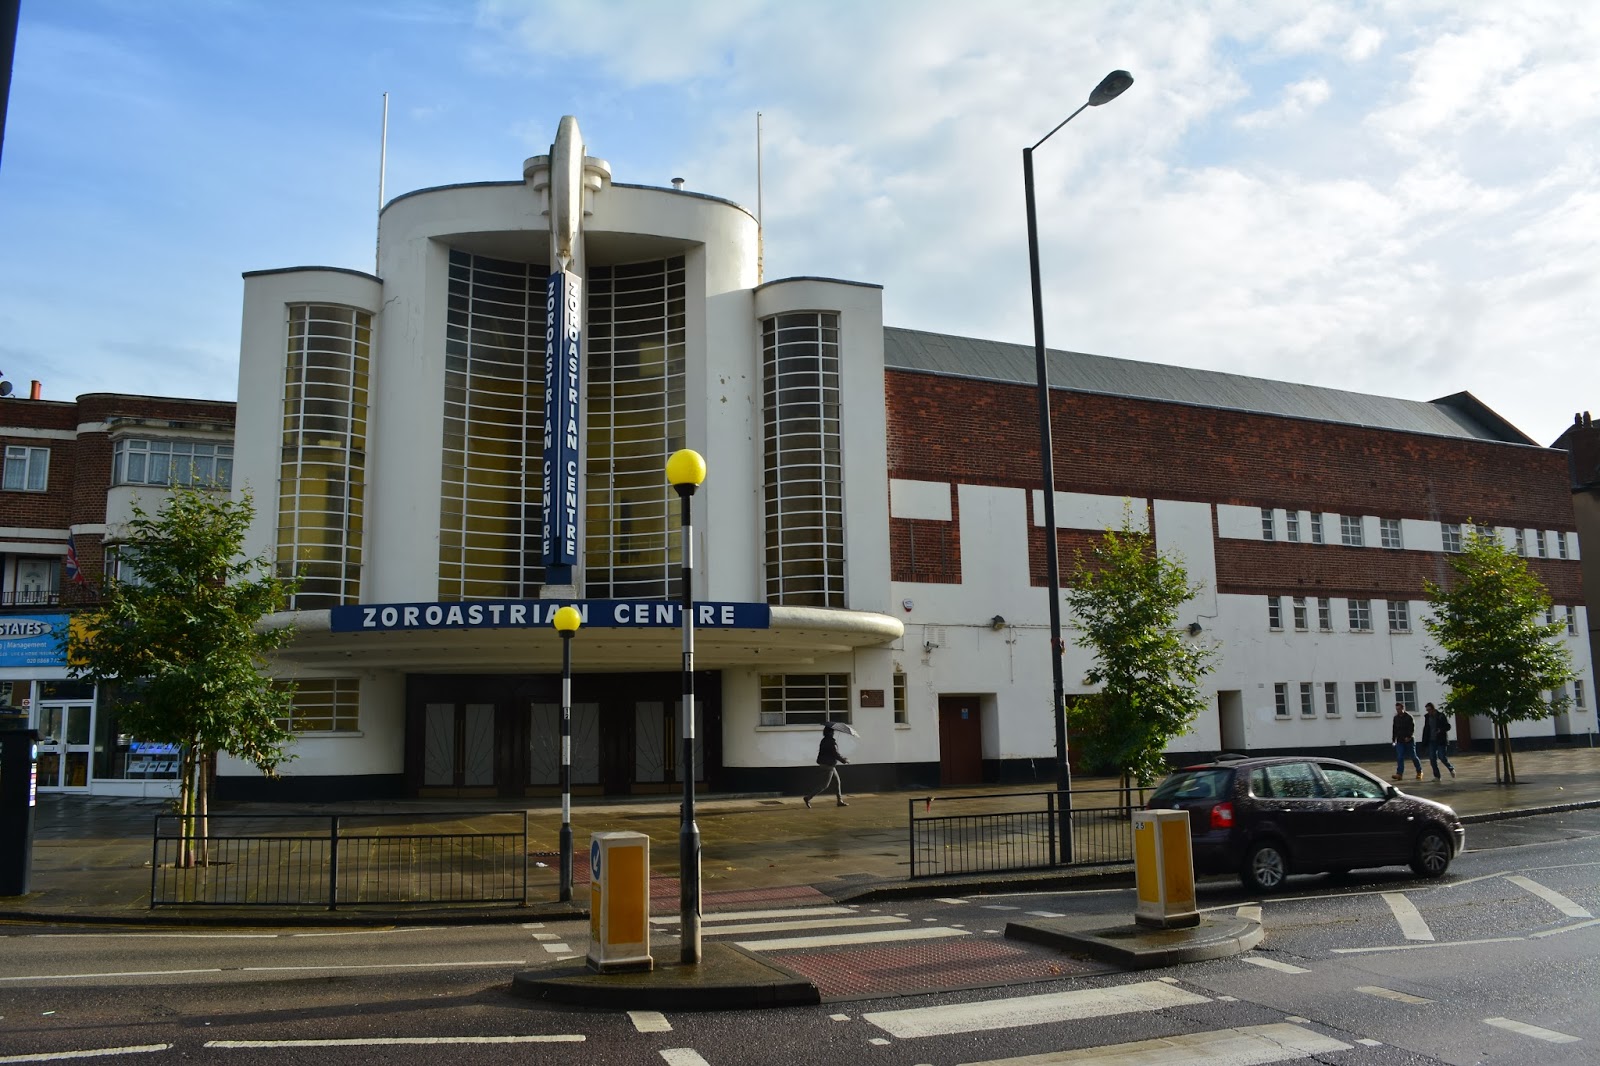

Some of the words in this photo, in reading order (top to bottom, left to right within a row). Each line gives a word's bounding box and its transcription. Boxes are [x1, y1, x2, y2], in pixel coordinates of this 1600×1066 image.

[544, 281, 555, 450] ZOROASTRIAN
[566, 281, 579, 450] ZOROASTRIAN
[543, 460, 551, 556] CENTRE
[566, 460, 577, 556] CENTRE
[614, 604, 735, 625] CENRE
[1135, 821, 1145, 830] 25
